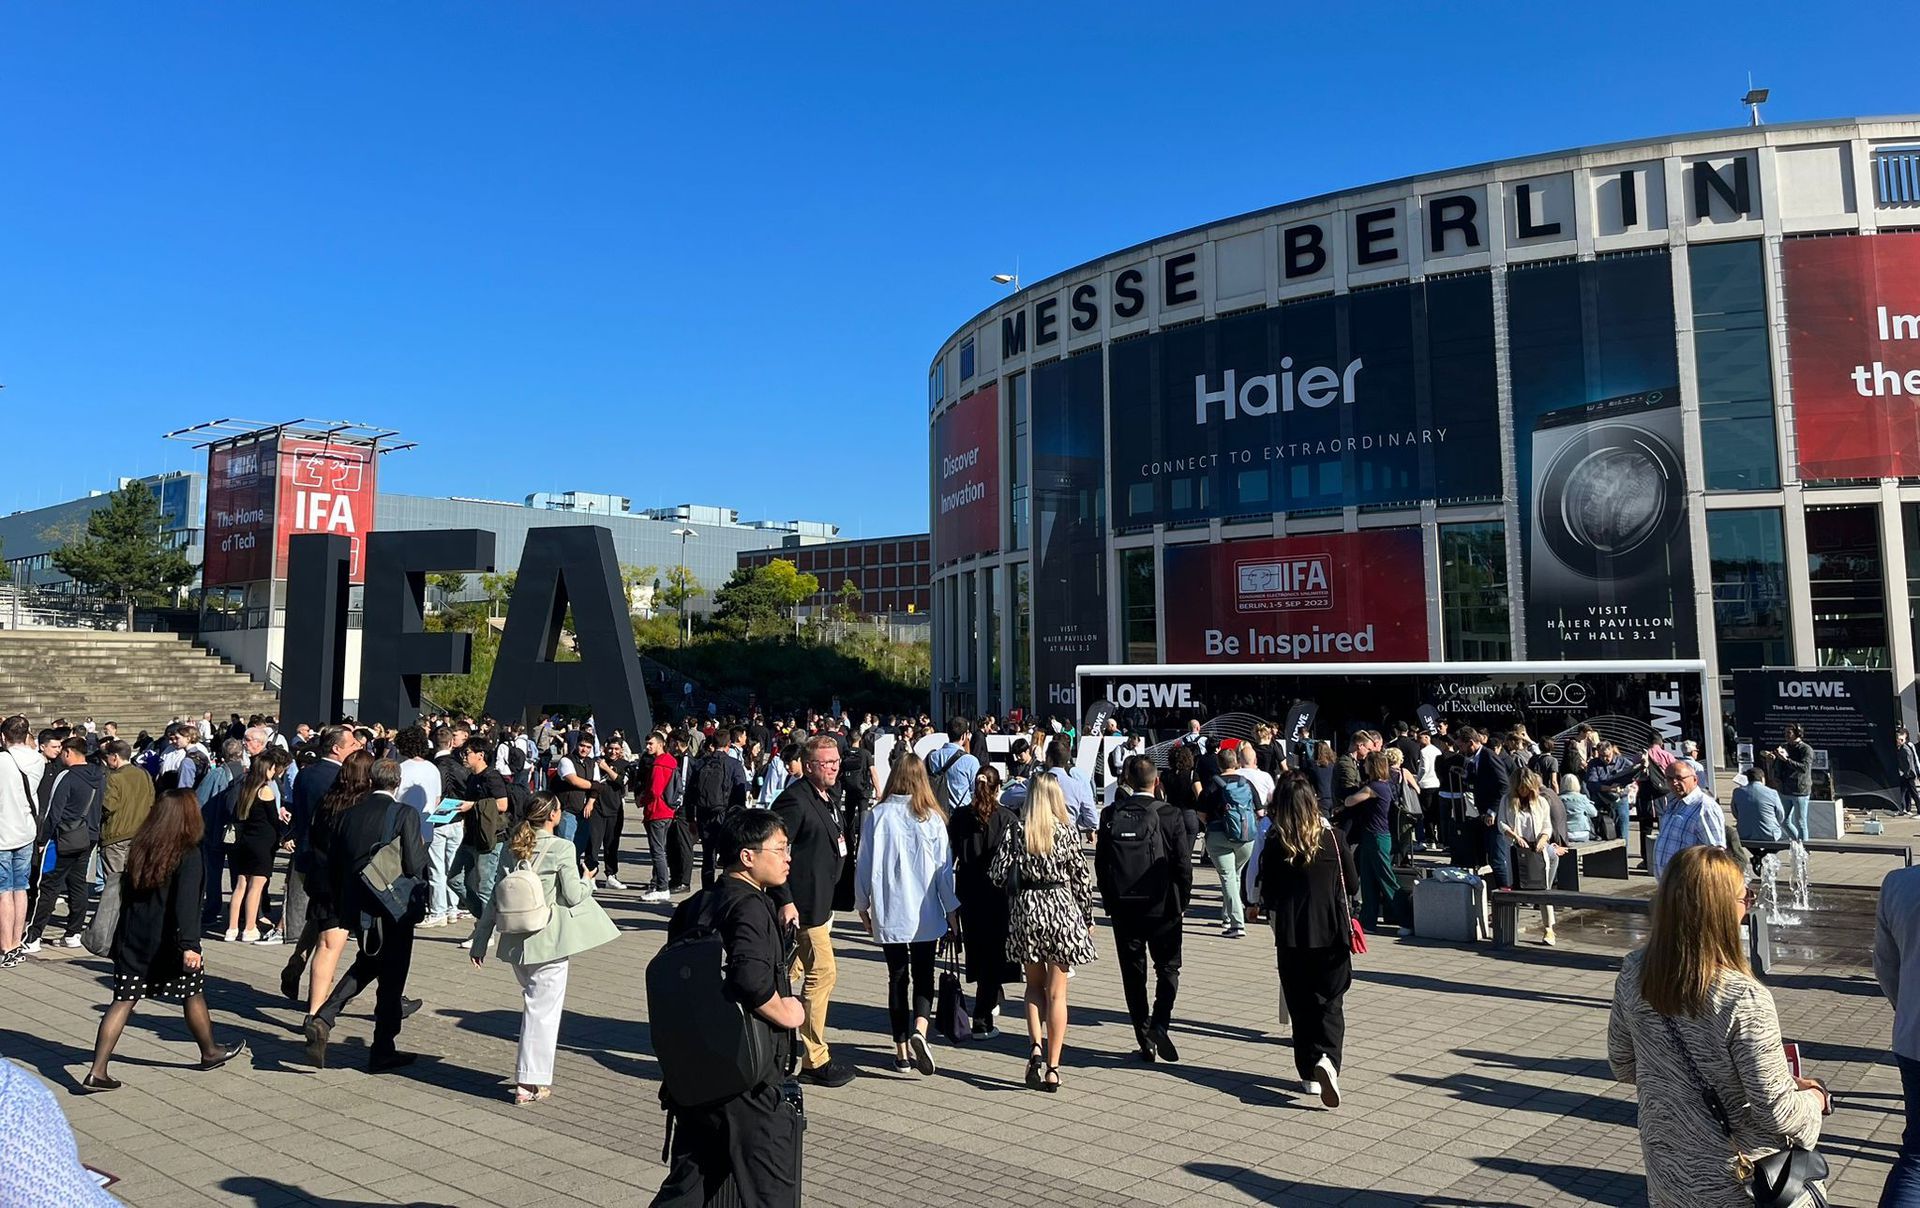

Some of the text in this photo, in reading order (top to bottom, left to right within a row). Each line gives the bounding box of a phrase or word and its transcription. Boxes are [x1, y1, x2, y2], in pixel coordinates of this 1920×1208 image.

[1002, 156, 1751, 359] MESSE BERLIN
[1195, 356, 1363, 424] Haier
[1851, 361, 1920, 397] the
[943, 447, 980, 479] Discover
[1141, 427, 1447, 476] CONNECT TO EXTRAORDINARY
[941, 480, 985, 514] Innovation
[217, 508, 264, 528] The Home
[295, 490, 356, 533] IFA
[221, 532, 256, 552] of Tech
[1282, 560, 1328, 591] IFA
[1304, 599, 1328, 607] 2023
[1588, 606, 1628, 615] VISIT
[280, 526, 652, 740] IFA
[1060, 625, 1078, 633] VISIT
[1547, 618, 1672, 628] HAIER PAVILLON
[1064, 634, 1098, 643] PAVILLON
[1205, 624, 1375, 660] Be Inspired
[1564, 631, 1656, 641] AT HALL 3.1
[1049, 683, 1076, 704] Hai
[1106, 683, 1200, 708] LOEWE.
[1436, 683, 1497, 697] A Century
[1778, 681, 1851, 698] LOEWE.
[1437, 700, 1516, 713] of Excellence.
[1649, 681, 1683, 756] EWE.
[1091, 711, 1107, 735] OEWE.
